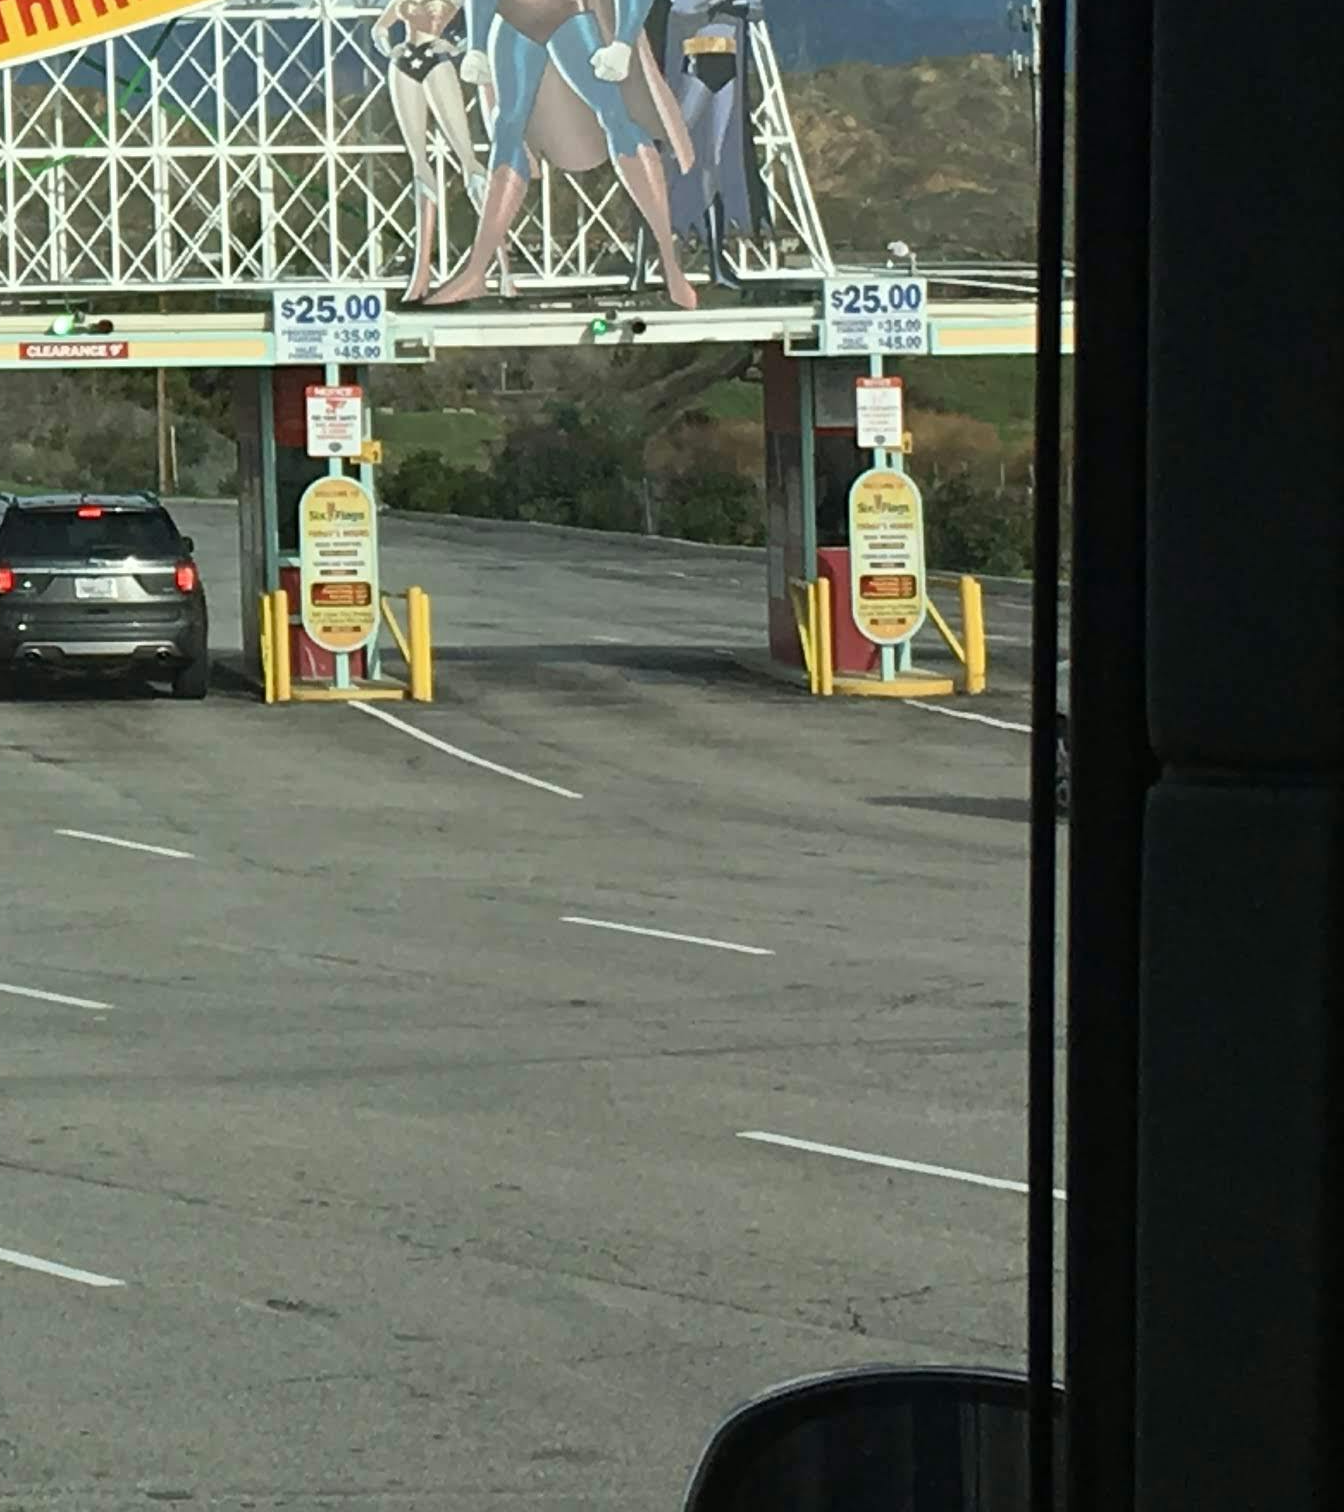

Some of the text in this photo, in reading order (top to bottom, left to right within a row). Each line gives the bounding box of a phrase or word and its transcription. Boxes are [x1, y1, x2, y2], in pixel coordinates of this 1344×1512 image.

[281, 295, 380, 323] $25.00
[831, 284, 921, 313] $25.00
[26, 345, 107, 357] CLEARANCE
